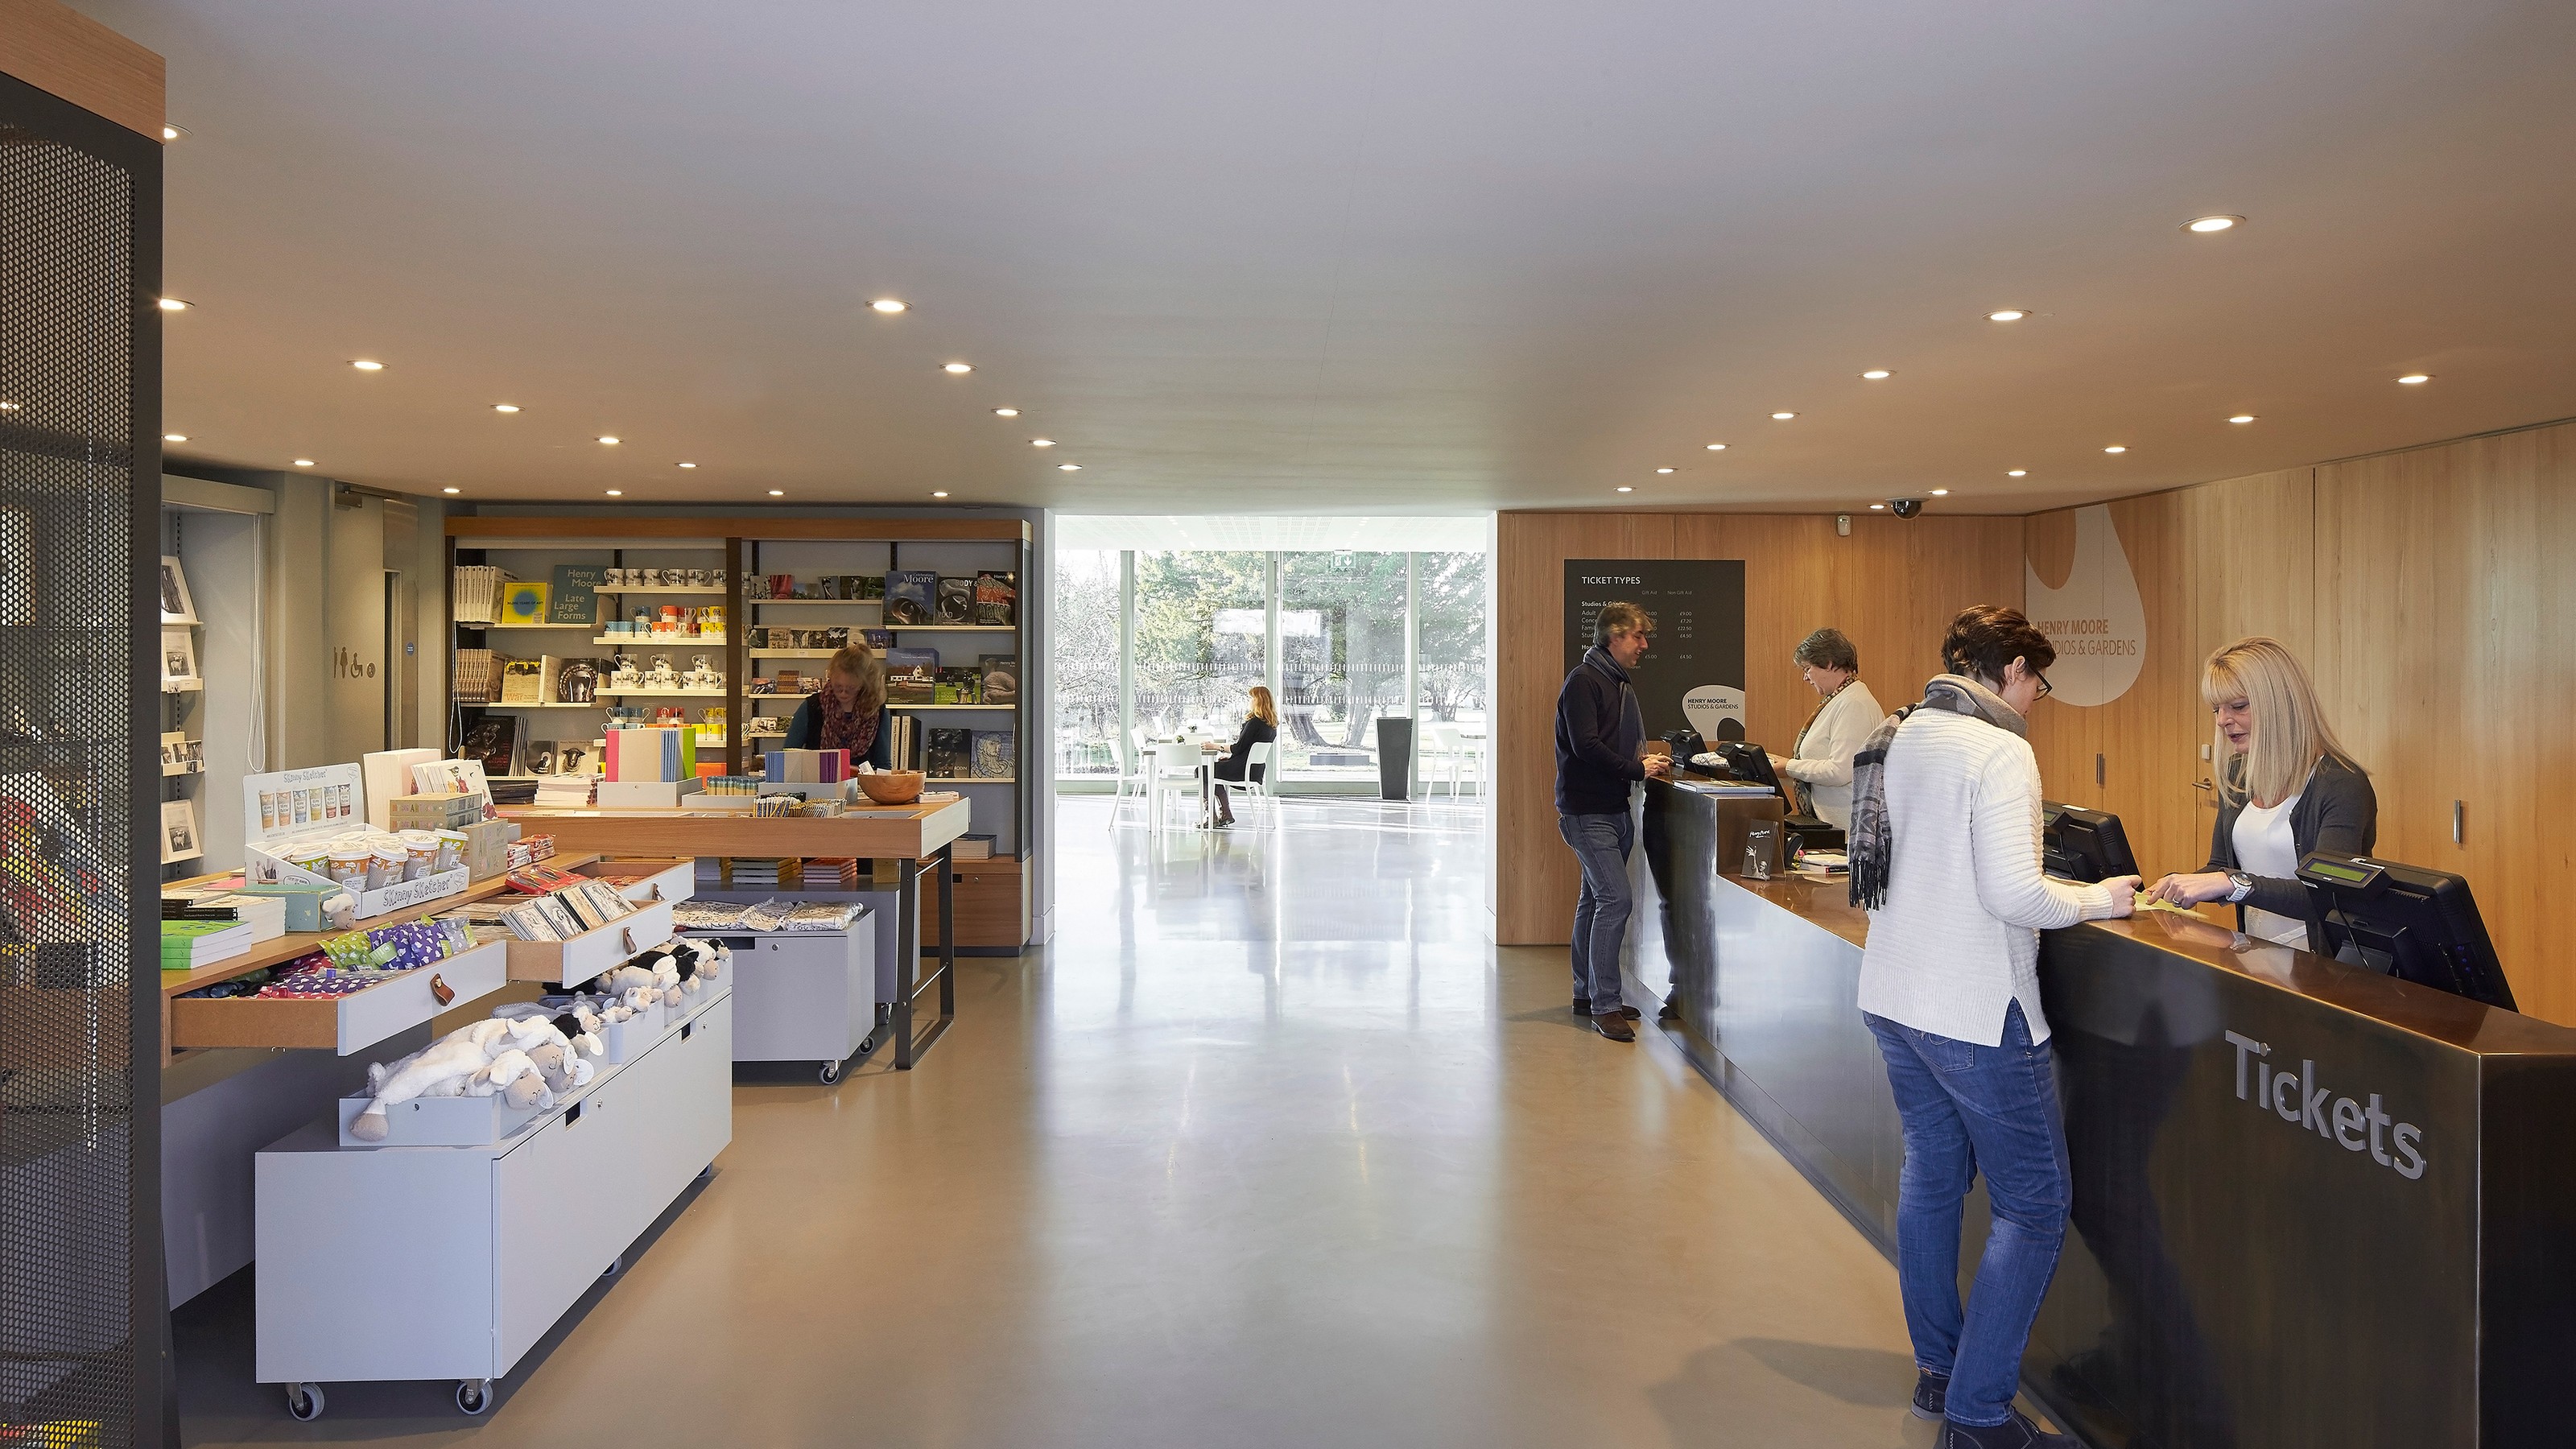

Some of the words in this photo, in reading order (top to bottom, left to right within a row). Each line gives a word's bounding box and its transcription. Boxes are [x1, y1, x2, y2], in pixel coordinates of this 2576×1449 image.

[568, 569, 596, 580] Henry
[903, 574, 934, 583] Moore
[572, 579, 601, 587] Moore
[1581, 576, 1612, 584] TICKET
[1614, 576, 1641, 584] TYPES
[565, 594, 585, 602] Late
[554, 602, 579, 612] Large
[558, 612, 586, 620] Forms
[2037, 620, 2069, 635] HENRY
[2071, 619, 2109, 634] MOORE
[2052, 640, 2076, 655] DIOS
[2078, 640, 2086, 655] &
[2088, 639, 2136, 656] GARDENS
[506, 693, 523, 701] War
[2225, 1029, 2427, 1179] Tickets
